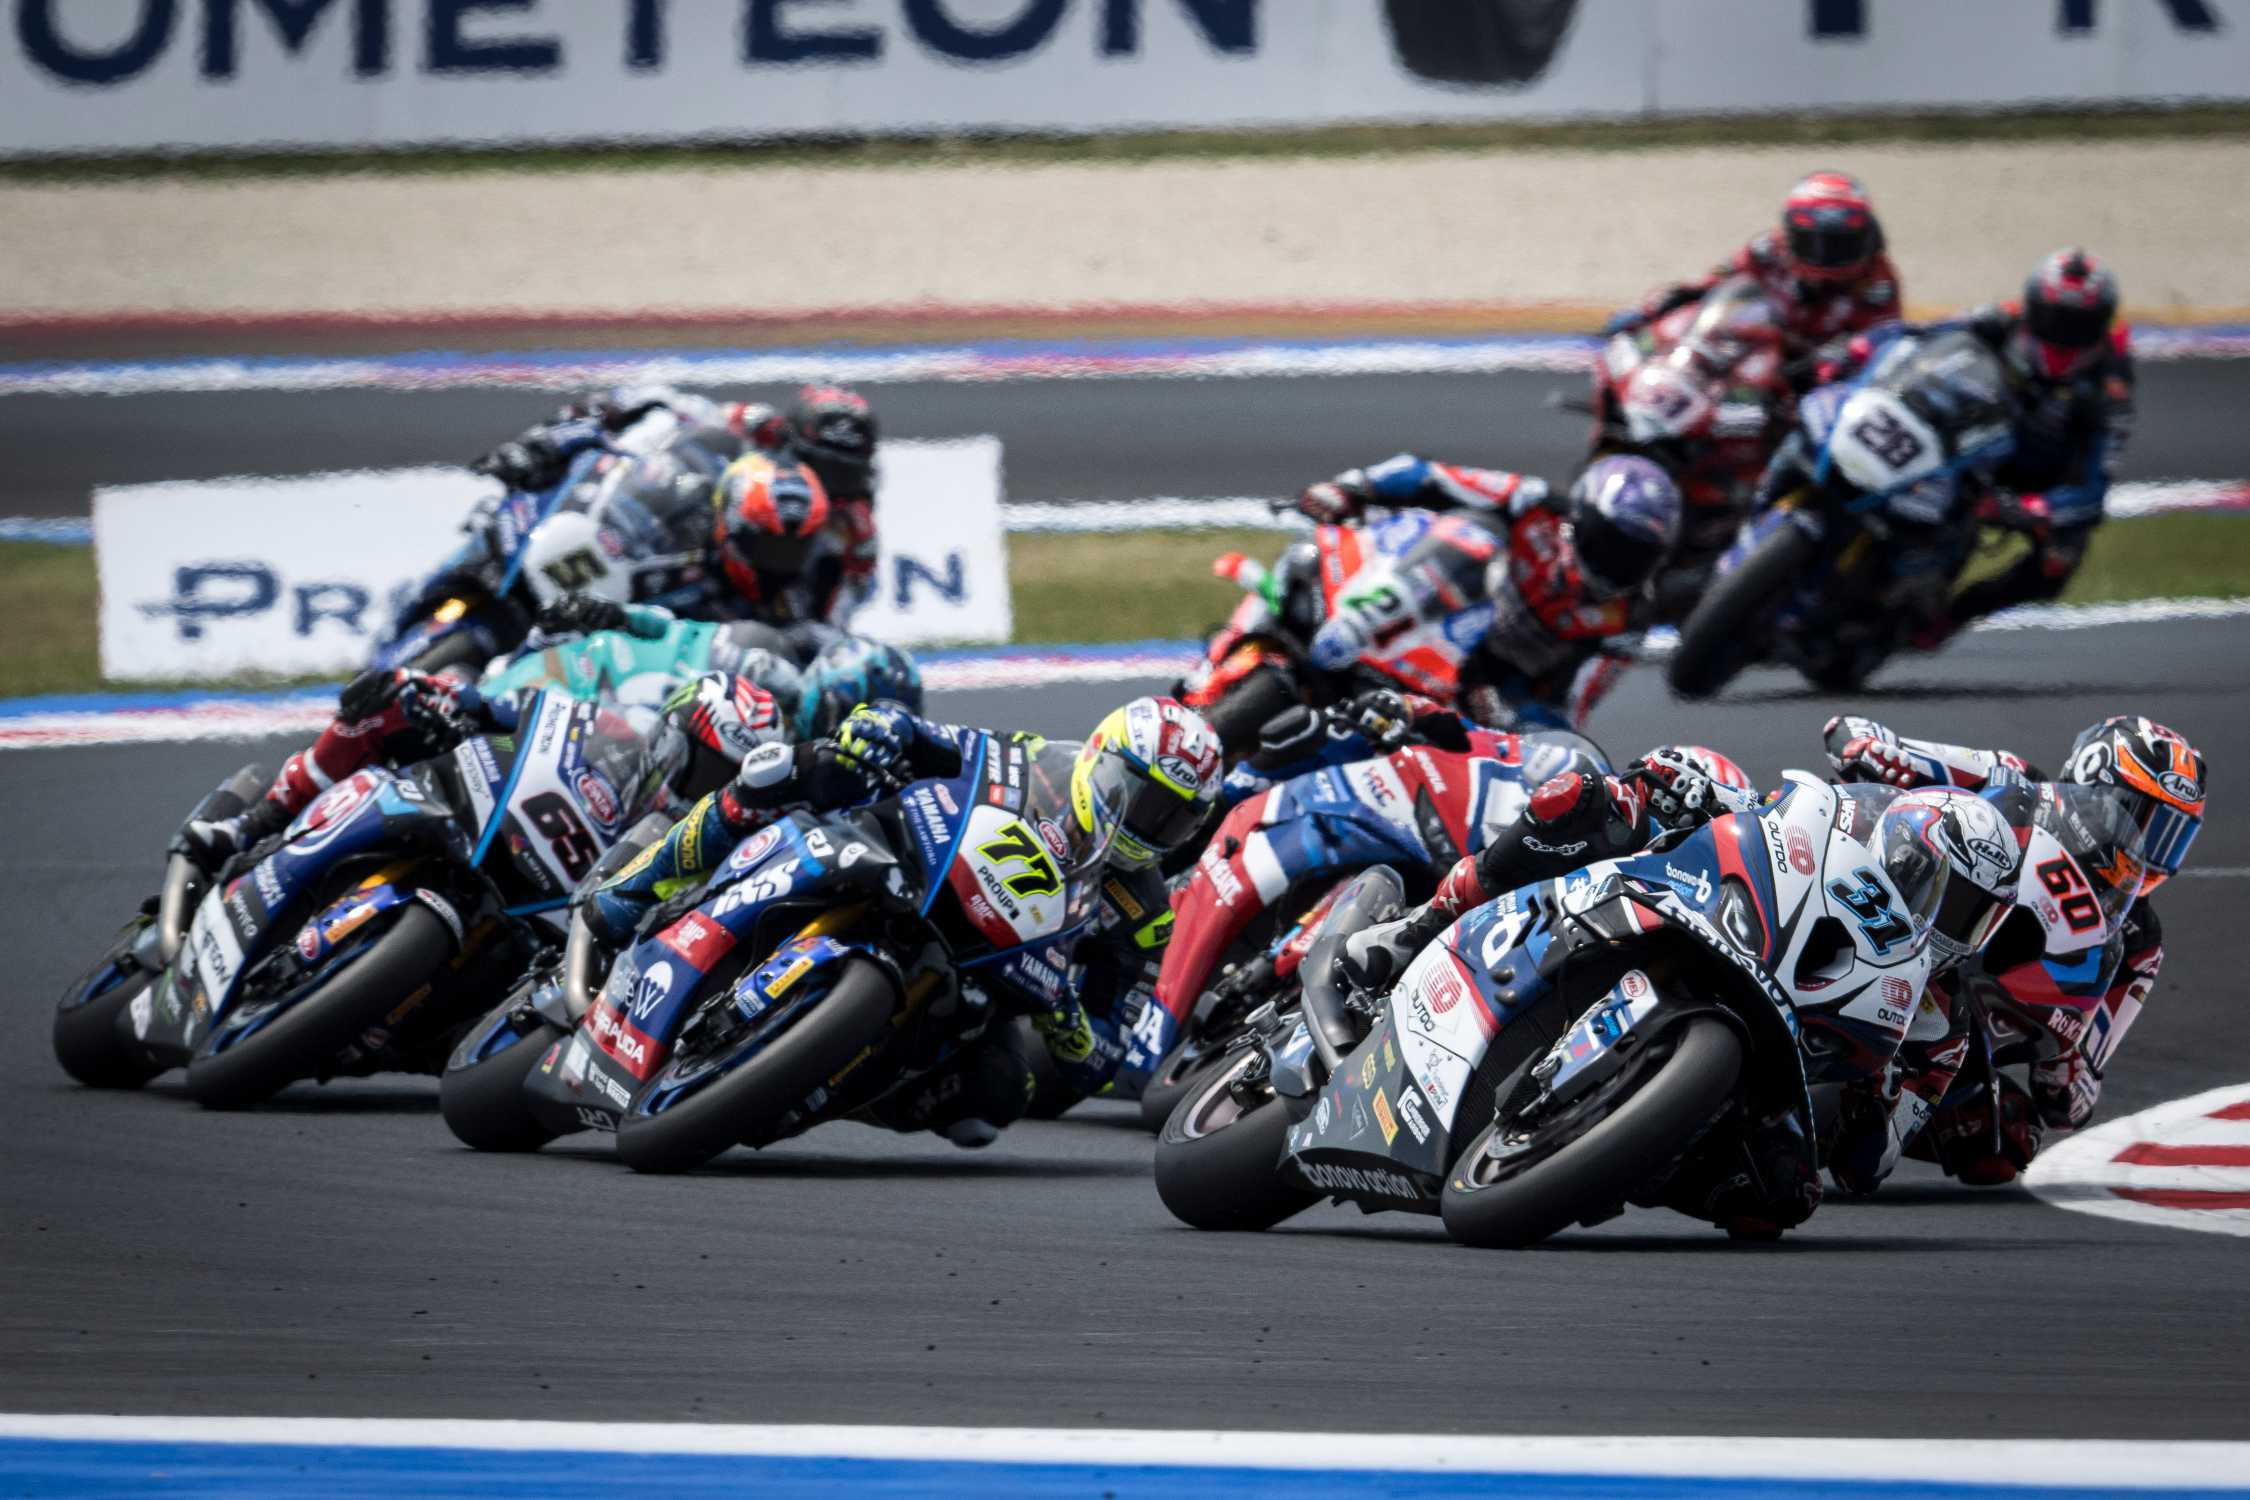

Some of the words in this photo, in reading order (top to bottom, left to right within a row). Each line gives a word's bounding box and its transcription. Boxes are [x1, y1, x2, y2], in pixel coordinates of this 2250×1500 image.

[1160, 758, 1197, 787] Arai
[521, 792, 599, 883] 65
[913, 787, 951, 845] YAMAHA
[1768, 820, 1788, 874] OUTDO
[977, 820, 1064, 899] 77
[1972, 841, 2010, 868] HJC
[1825, 866, 1915, 956] 31
[2036, 850, 2101, 935] 60
